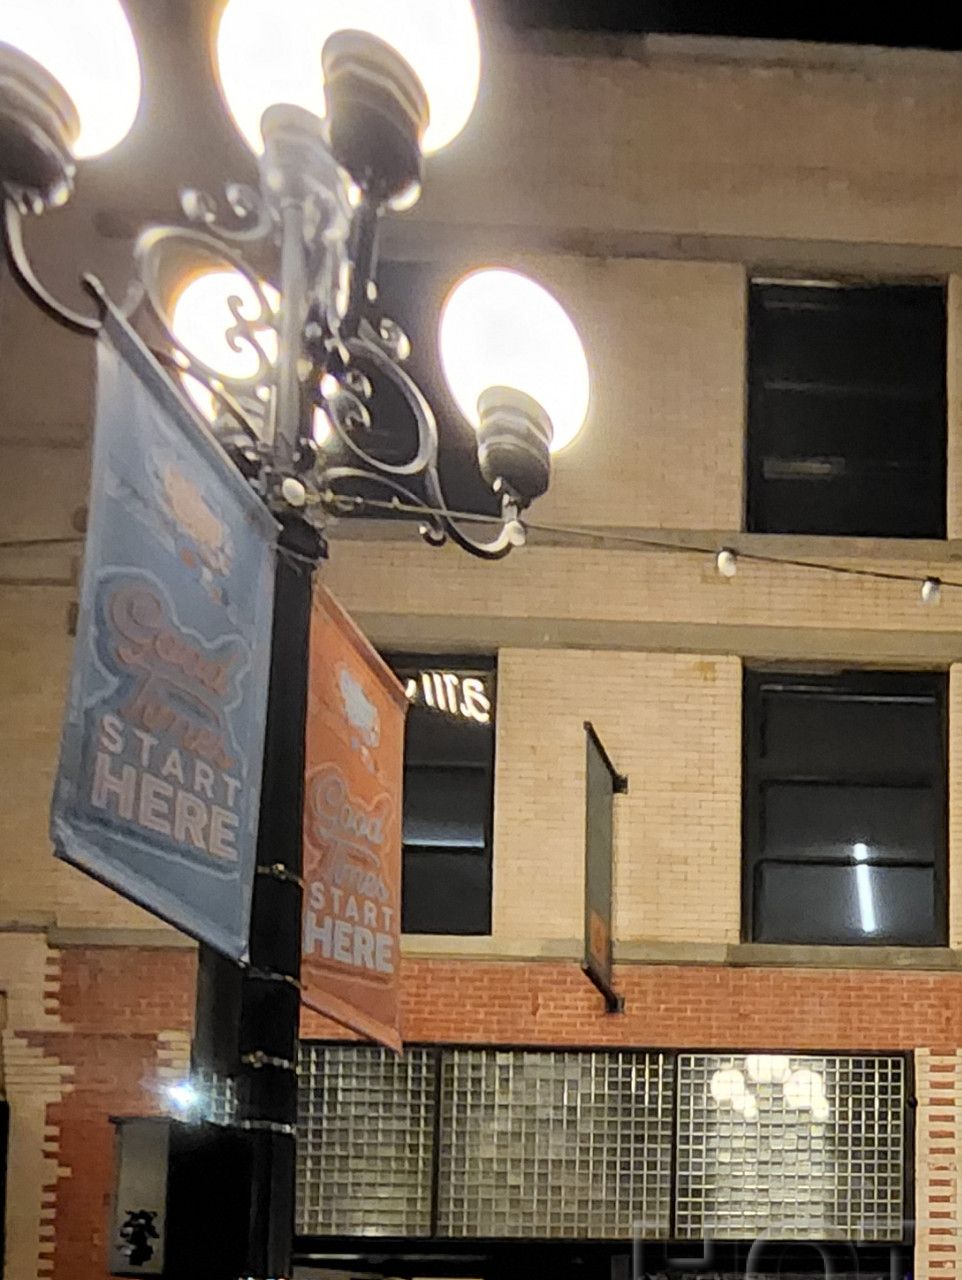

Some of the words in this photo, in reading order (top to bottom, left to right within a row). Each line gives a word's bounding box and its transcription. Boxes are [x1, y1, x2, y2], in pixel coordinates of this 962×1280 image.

[109, 588, 237, 694] Good
[101, 714, 242, 807] START
[91, 752, 239, 861] HERE
[313, 775, 384, 843] Good
[304, 911, 395, 973] HERE
[310, 881, 394, 931] START
